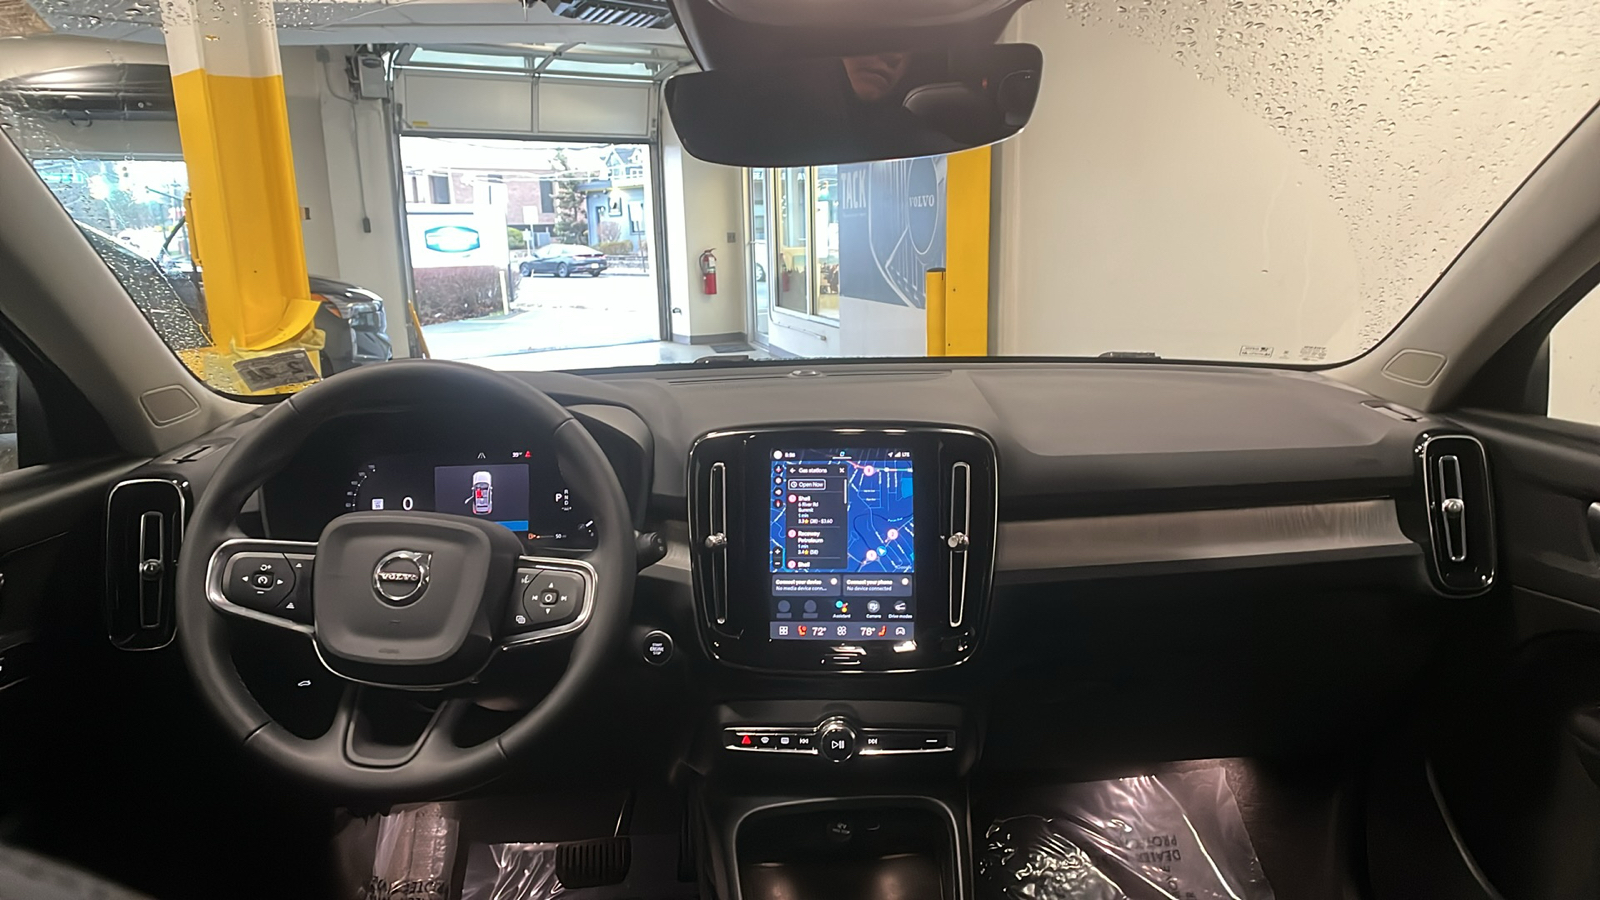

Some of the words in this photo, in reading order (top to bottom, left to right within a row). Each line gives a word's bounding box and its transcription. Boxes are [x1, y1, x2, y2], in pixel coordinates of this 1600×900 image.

[840, 169, 867, 209] TACK
[909, 194, 935, 207] VOLVO
[555, 493, 562, 502] P
[402, 496, 414, 511] 0
[379, 572, 418, 581] VOLVO
[812, 626, 826, 636] 72°
[860, 626, 876, 636] 78°
